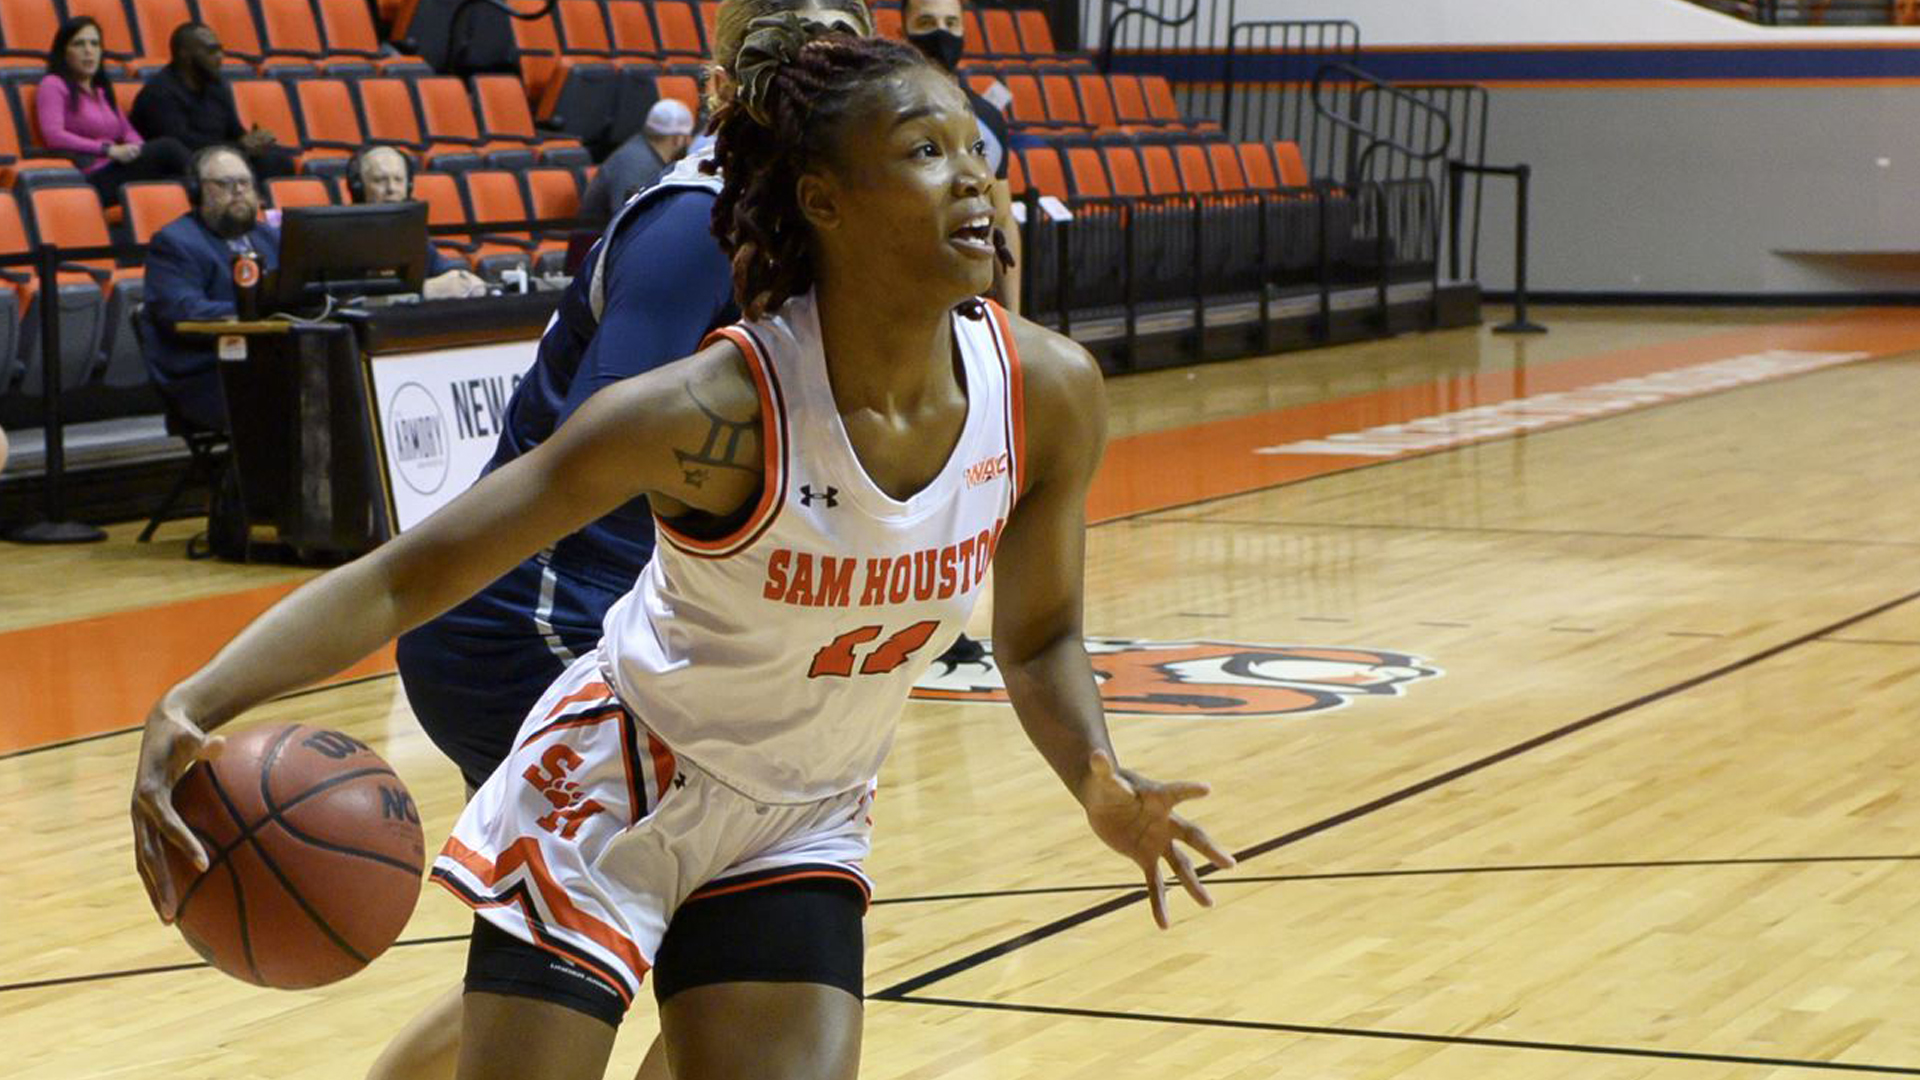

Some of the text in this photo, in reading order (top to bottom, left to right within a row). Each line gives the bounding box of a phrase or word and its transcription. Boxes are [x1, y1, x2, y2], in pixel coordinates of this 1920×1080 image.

[451, 376, 506, 440] NEW
[963, 453, 1006, 490] WAC
[763, 549, 856, 607] SAM
[378, 785, 421, 827] NC
